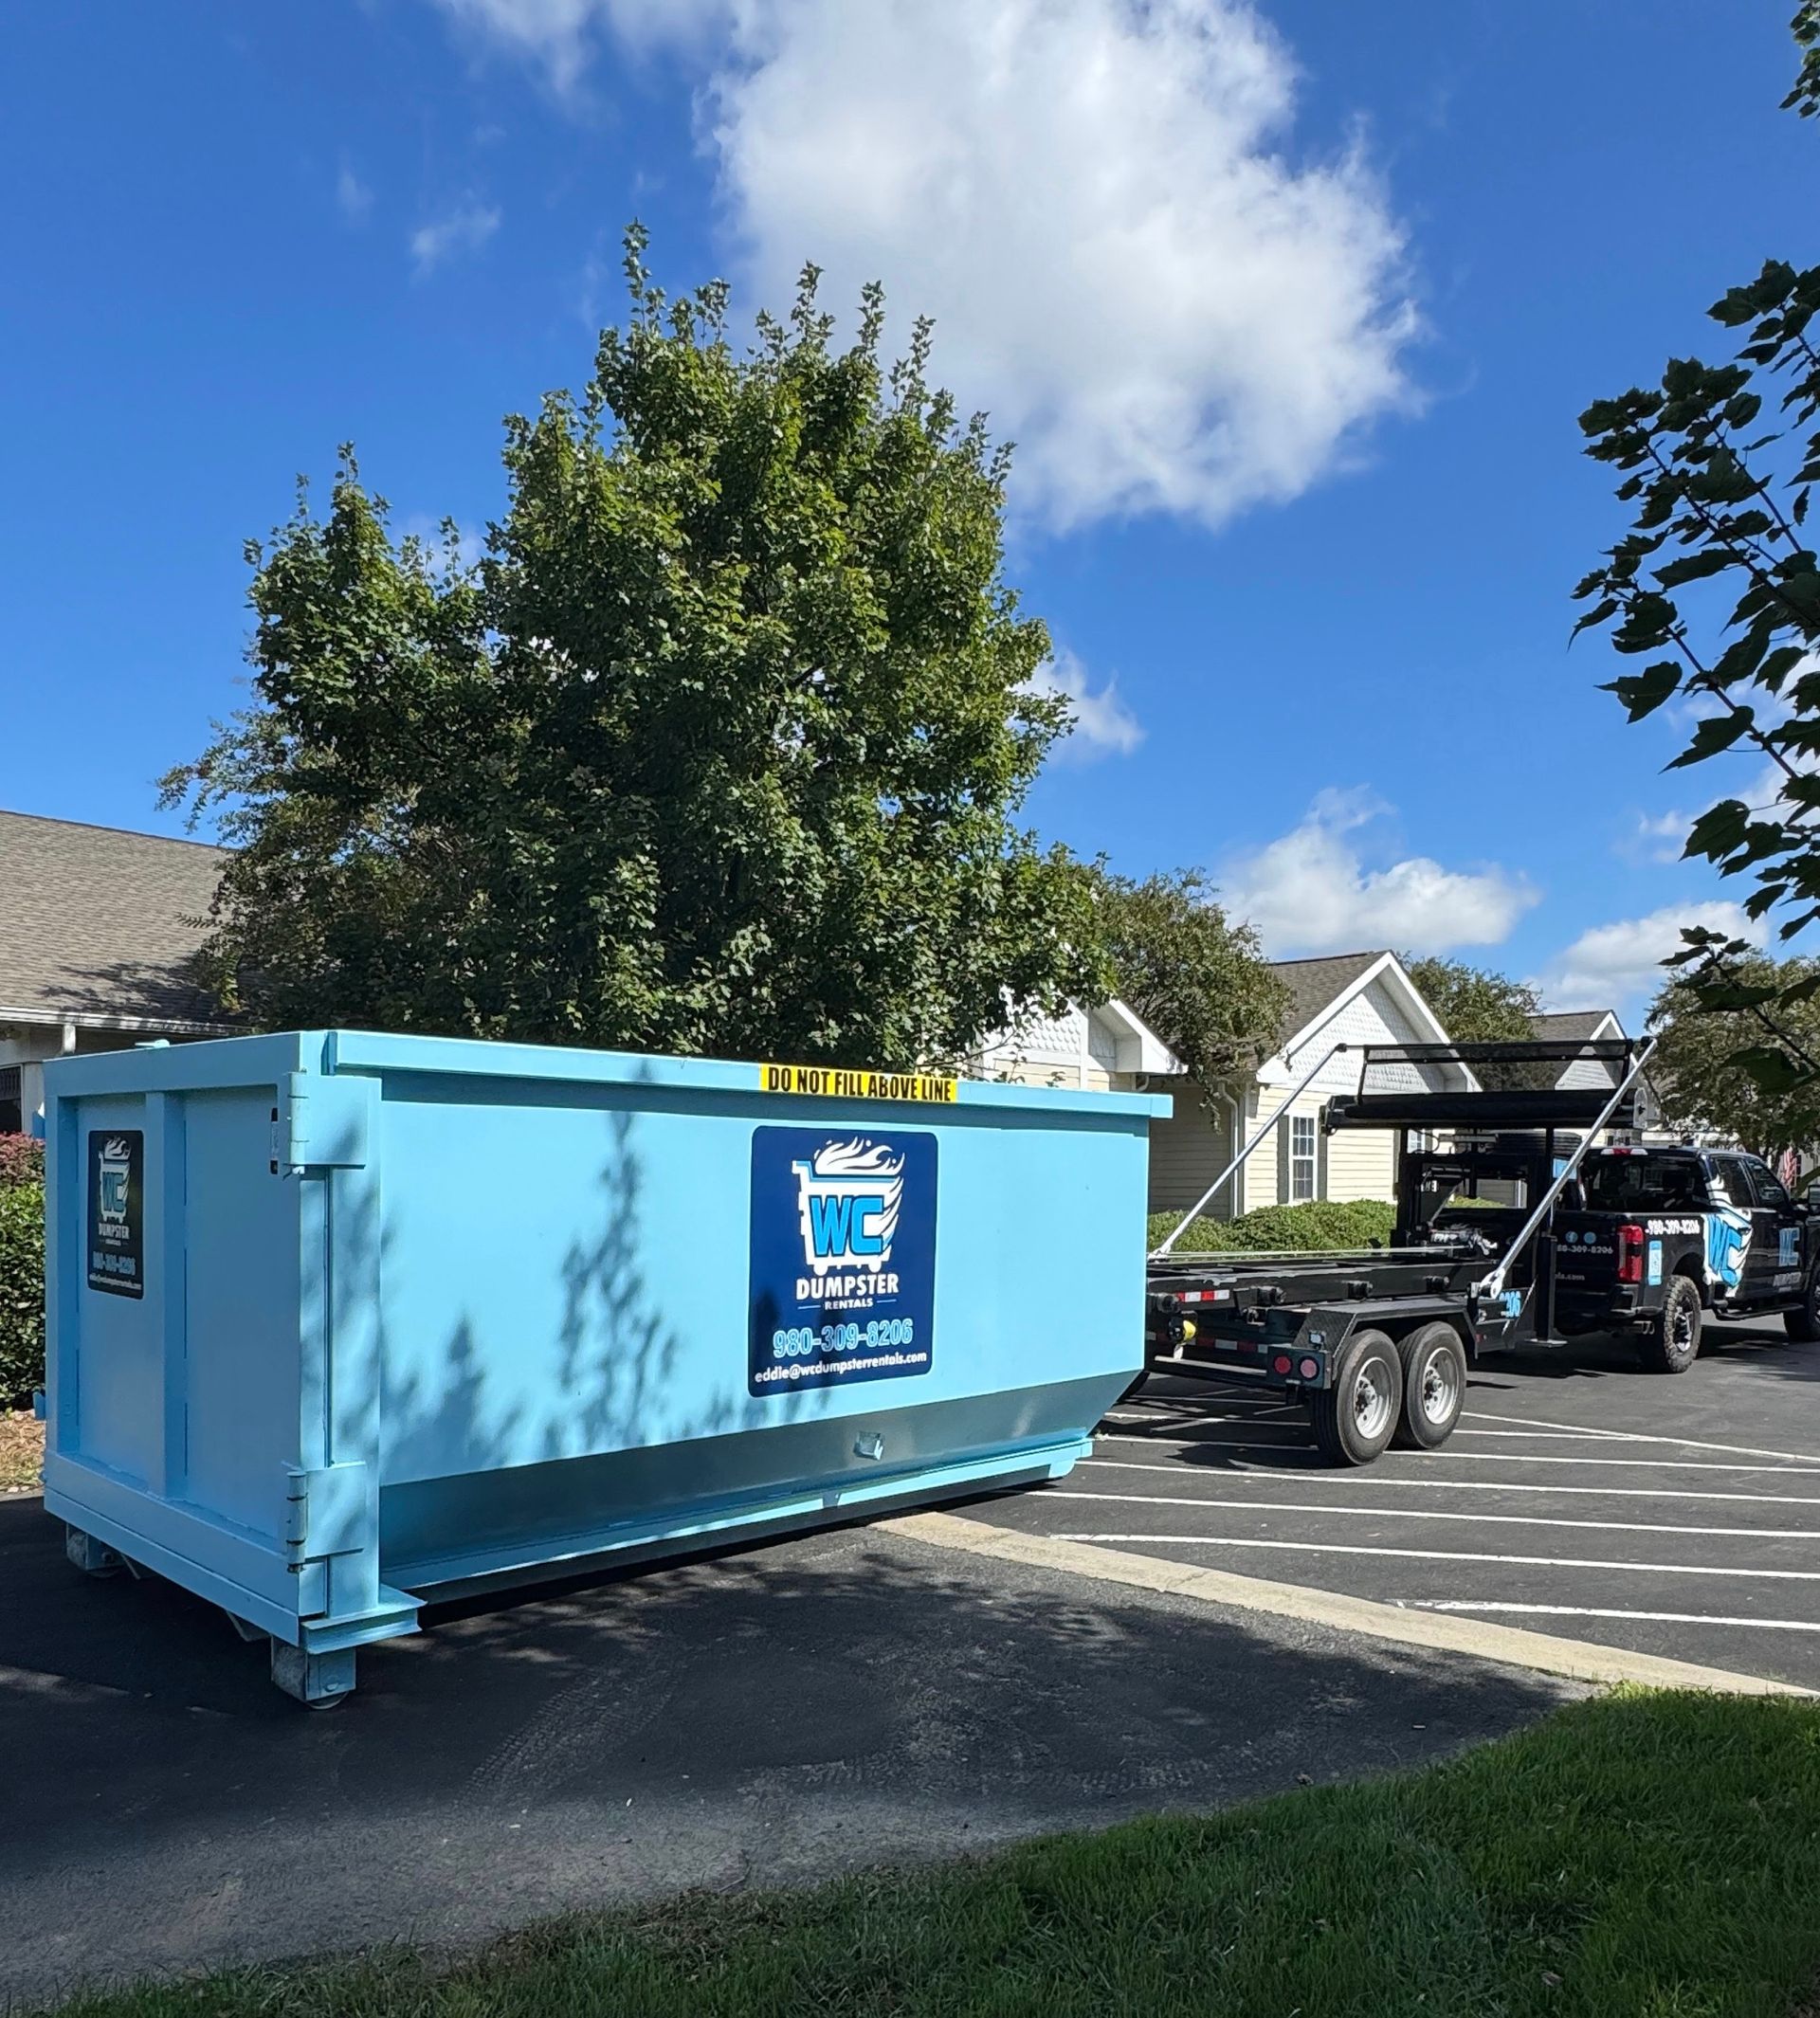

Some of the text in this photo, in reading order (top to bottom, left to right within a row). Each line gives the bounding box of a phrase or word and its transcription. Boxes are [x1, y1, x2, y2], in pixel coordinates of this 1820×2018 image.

[769, 1066, 952, 1101] DO NOT FILL ABOVE LINE
[809, 1193, 886, 1258] WC
[795, 1273, 900, 1300] DUMPSTER
[824, 1298, 874, 1310] RENTALS
[773, 1318, 914, 1359] 980-309-8206
[755, 1352, 927, 1383] eddie@wcdumpsterrentals.com
